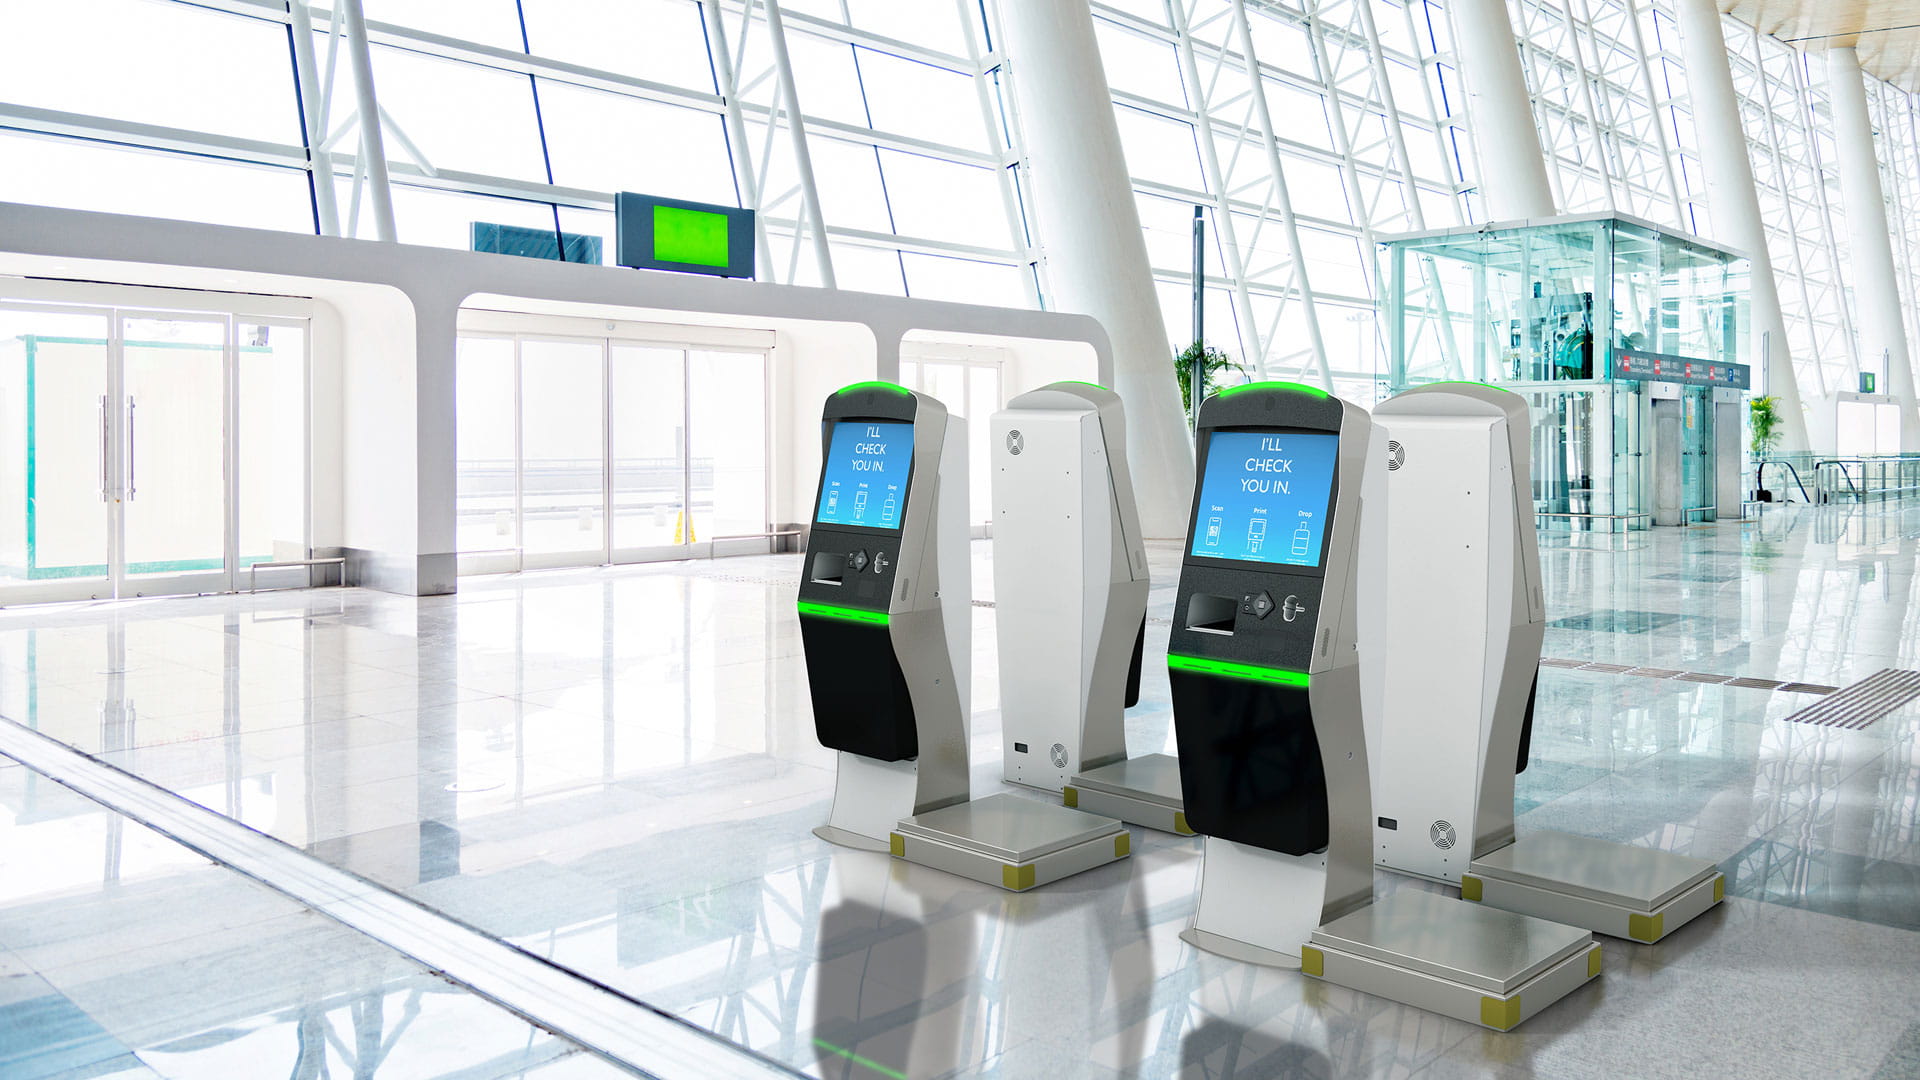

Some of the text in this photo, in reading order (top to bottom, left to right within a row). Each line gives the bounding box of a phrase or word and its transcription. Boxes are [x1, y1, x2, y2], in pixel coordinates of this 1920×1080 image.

[867, 426, 880, 437] I'LL
[855, 442, 887, 455] CHECK
[1261, 438, 1282, 451] I'LL
[851, 459, 885, 473] YOU IN.
[1245, 458, 1292, 473] CHECK
[1240, 478, 1291, 495] YOU IN.
[1211, 504, 1224, 512] Scan
[1298, 510, 1313, 518] Drop
